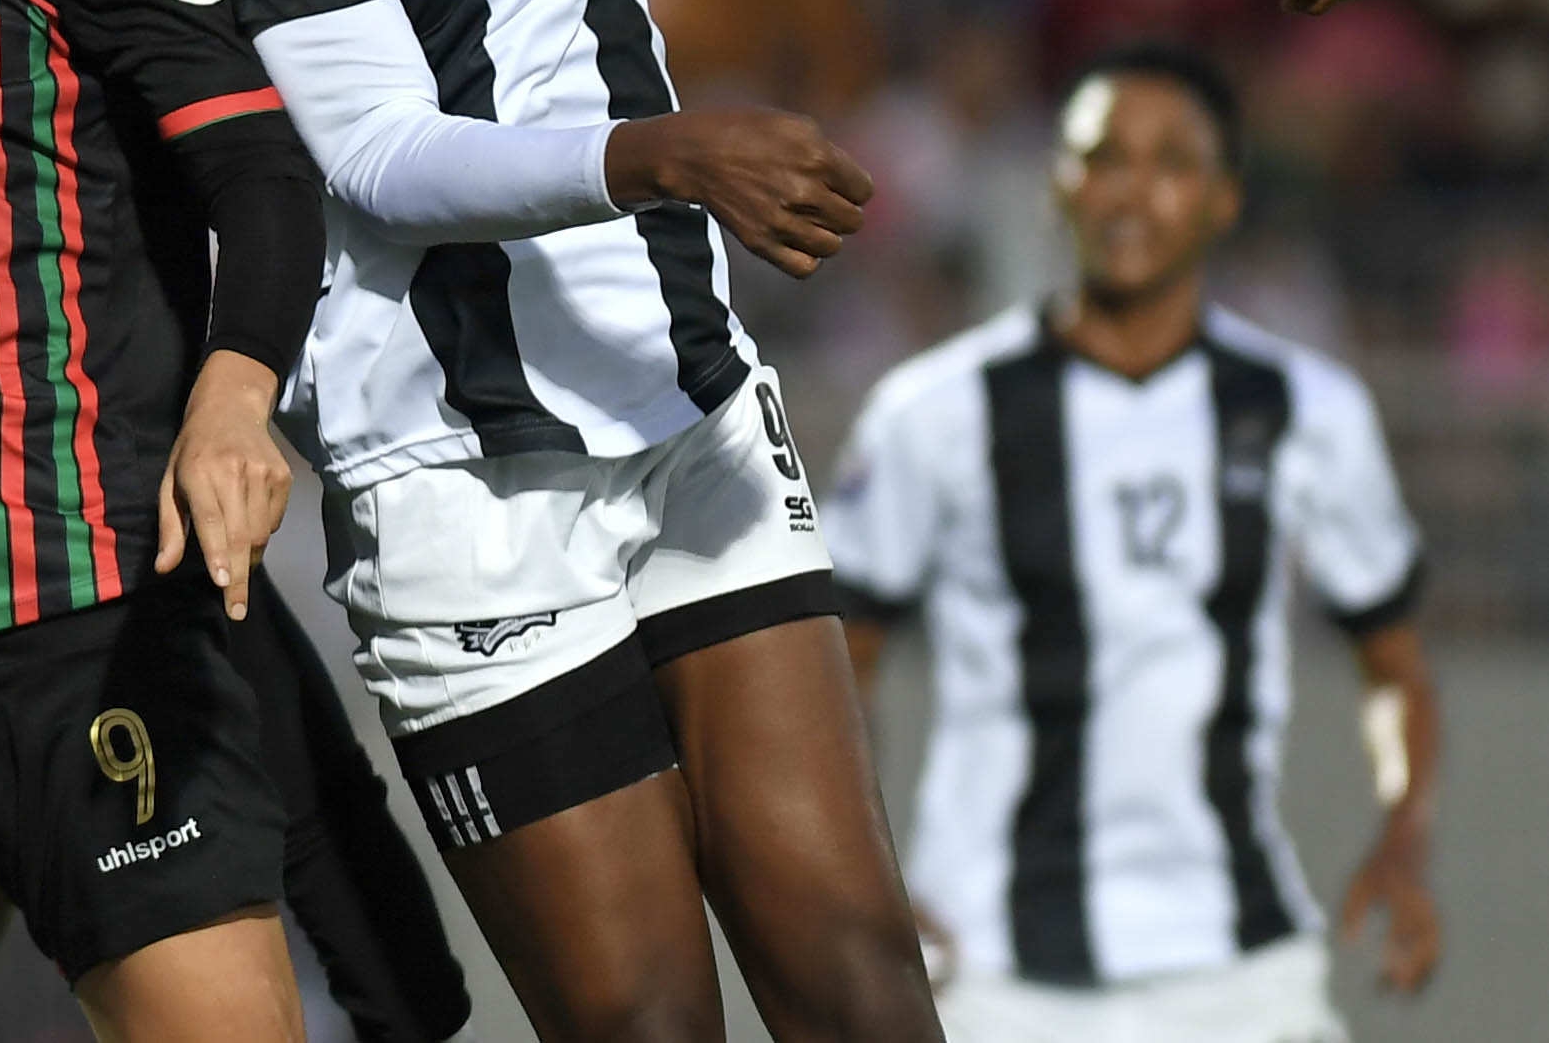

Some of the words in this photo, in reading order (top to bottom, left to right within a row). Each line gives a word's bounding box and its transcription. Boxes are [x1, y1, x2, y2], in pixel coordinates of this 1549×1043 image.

[755, 381, 801, 481] 9
[1114, 472, 1187, 570] 12
[90, 707, 156, 825] 9
[97, 817, 202, 873] uhlsport
